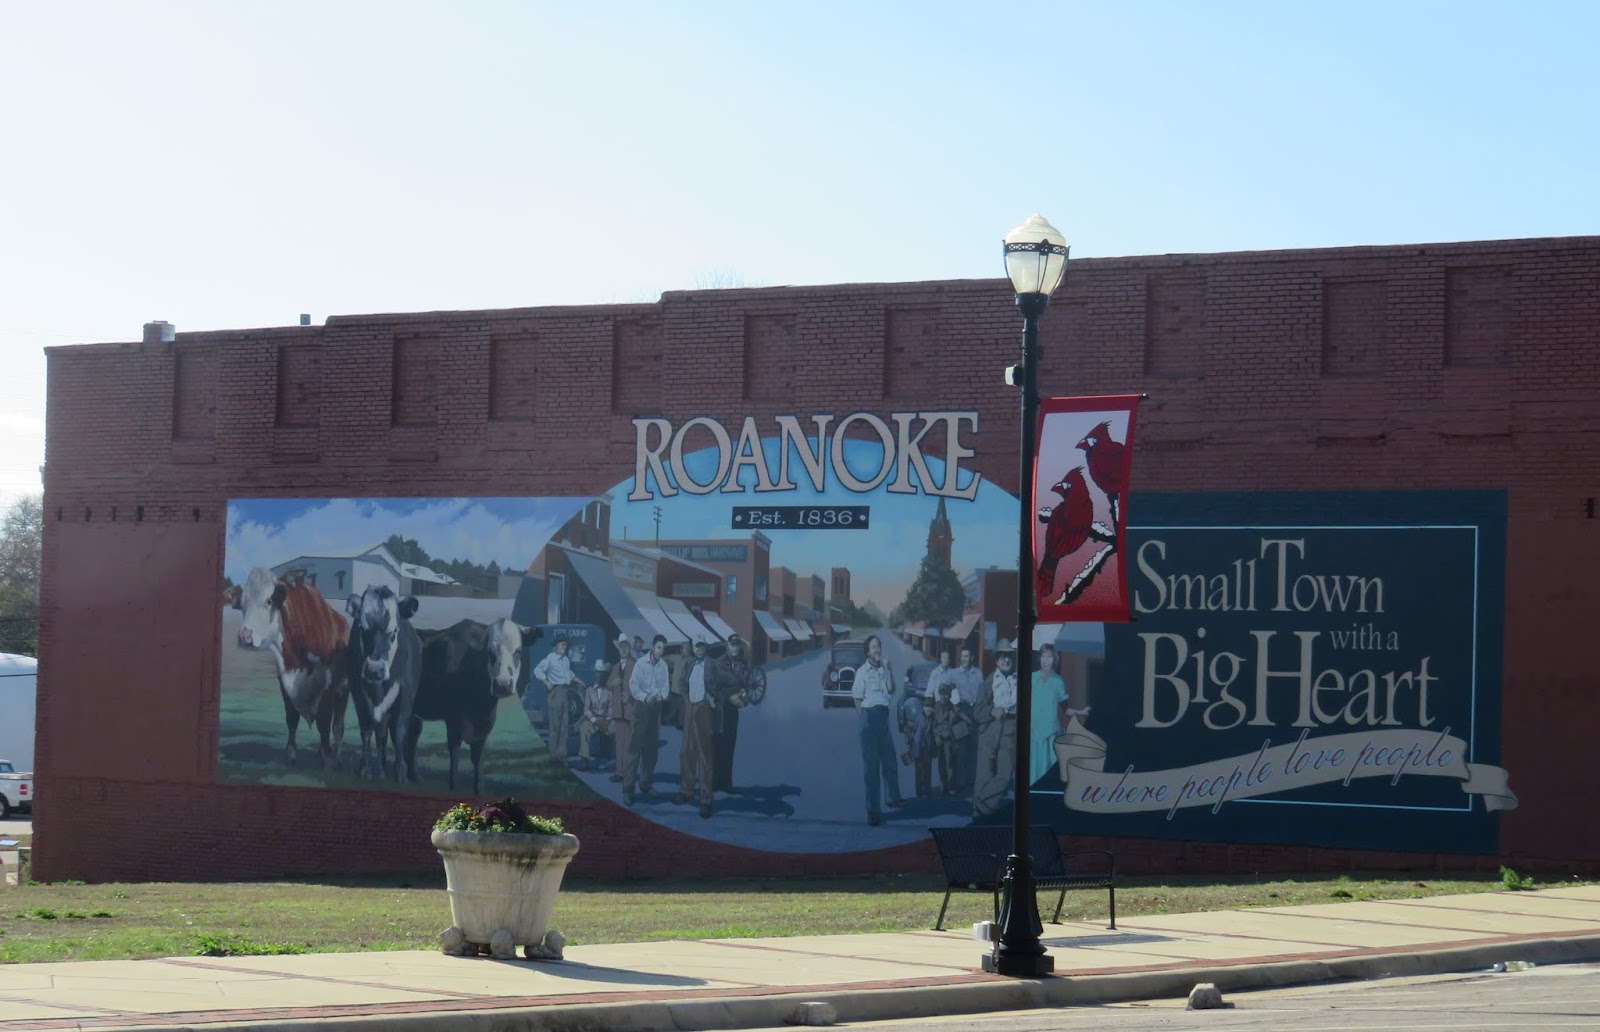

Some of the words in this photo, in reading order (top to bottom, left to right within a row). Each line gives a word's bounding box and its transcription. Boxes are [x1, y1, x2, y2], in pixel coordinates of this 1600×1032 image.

[627, 411, 982, 501] ROANOKE
[747, 510, 787, 526] Est.
[796, 509, 853, 526] 1836
[1135, 539, 1257, 614] Small
[1260, 537, 1385, 614] Town
[1329, 622, 1381, 651] with
[1385, 629, 1400, 651] a
[1135, 627, 1248, 731] Big
[1246, 630, 1439, 729] Heart
[1080, 764, 1168, 804] where
[1166, 738, 1273, 820] people
[1284, 727, 1345, 777] love
[1343, 727, 1454, 787] people
